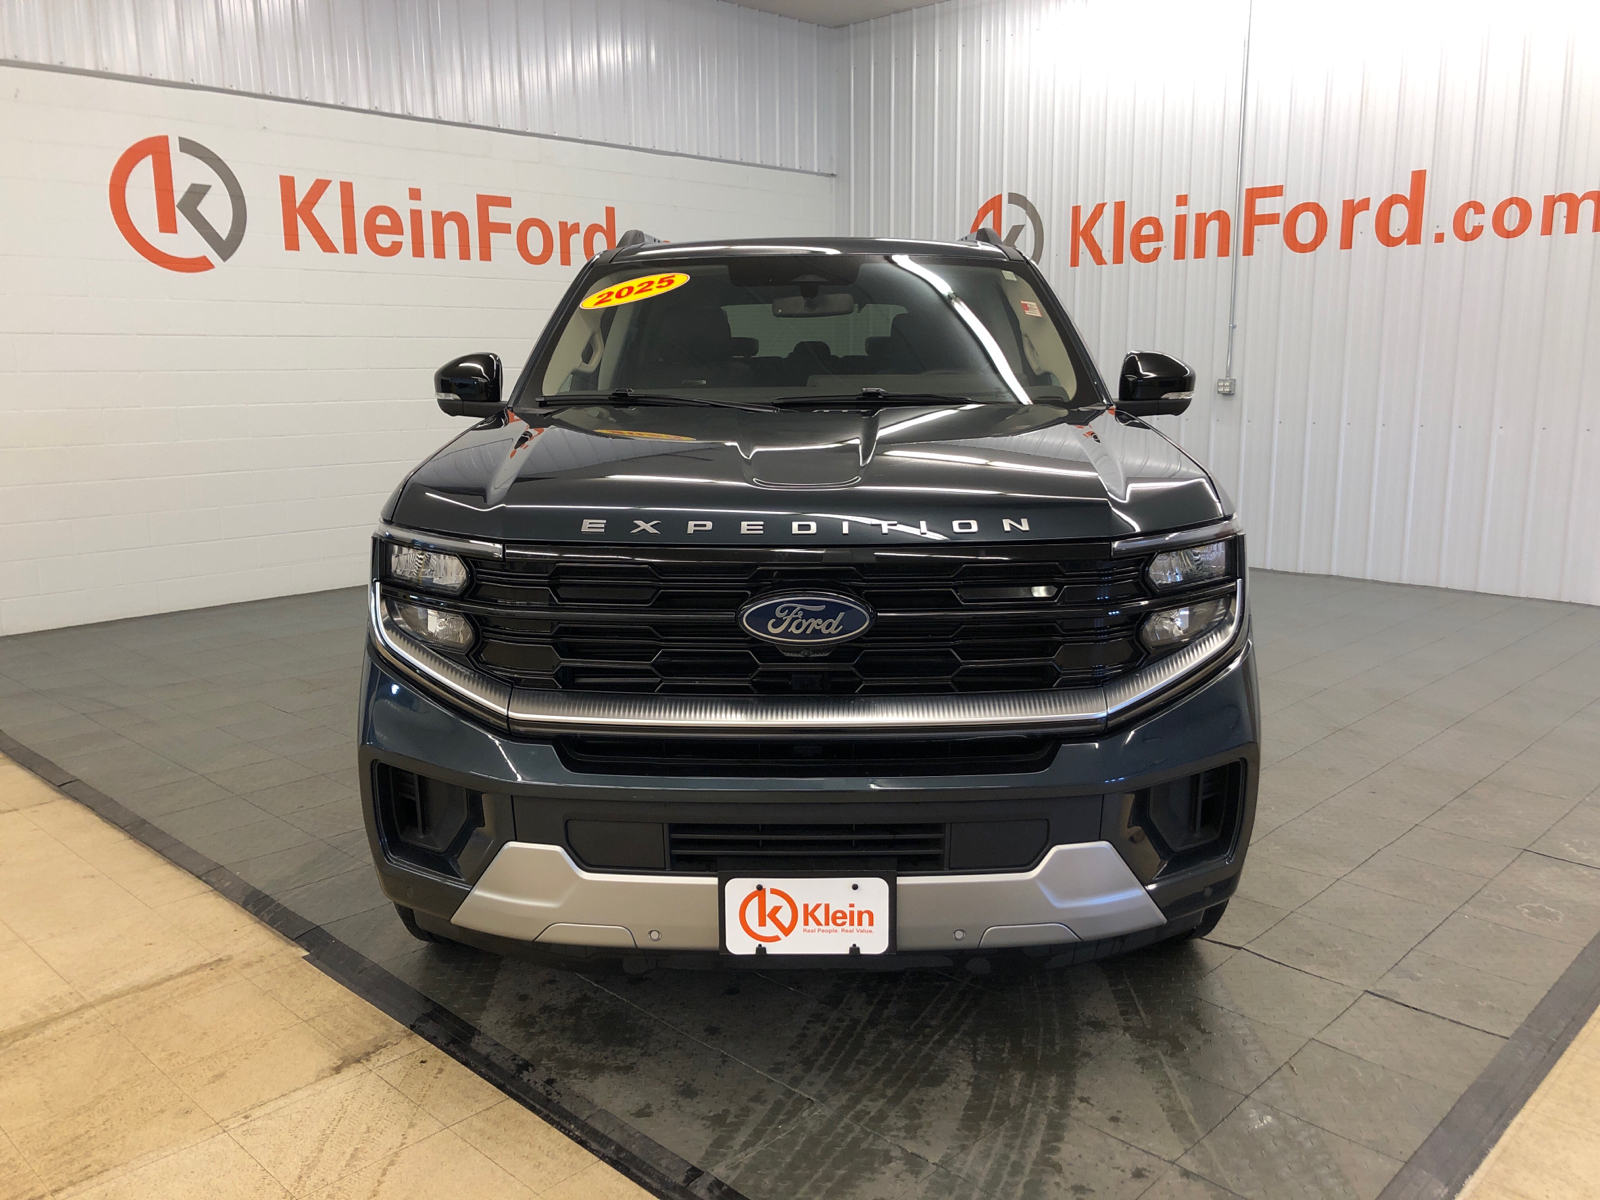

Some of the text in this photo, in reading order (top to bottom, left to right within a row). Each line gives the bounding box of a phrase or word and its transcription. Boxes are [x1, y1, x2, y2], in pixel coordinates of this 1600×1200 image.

[279, 174, 617, 267] KleinFord
[1070, 169, 1600, 268] KleinFord.com
[593, 275, 676, 307] 2025
[580, 517, 1030, 535] EXPEDITION
[767, 603, 846, 635] Ford
[803, 903, 874, 927] Klein
